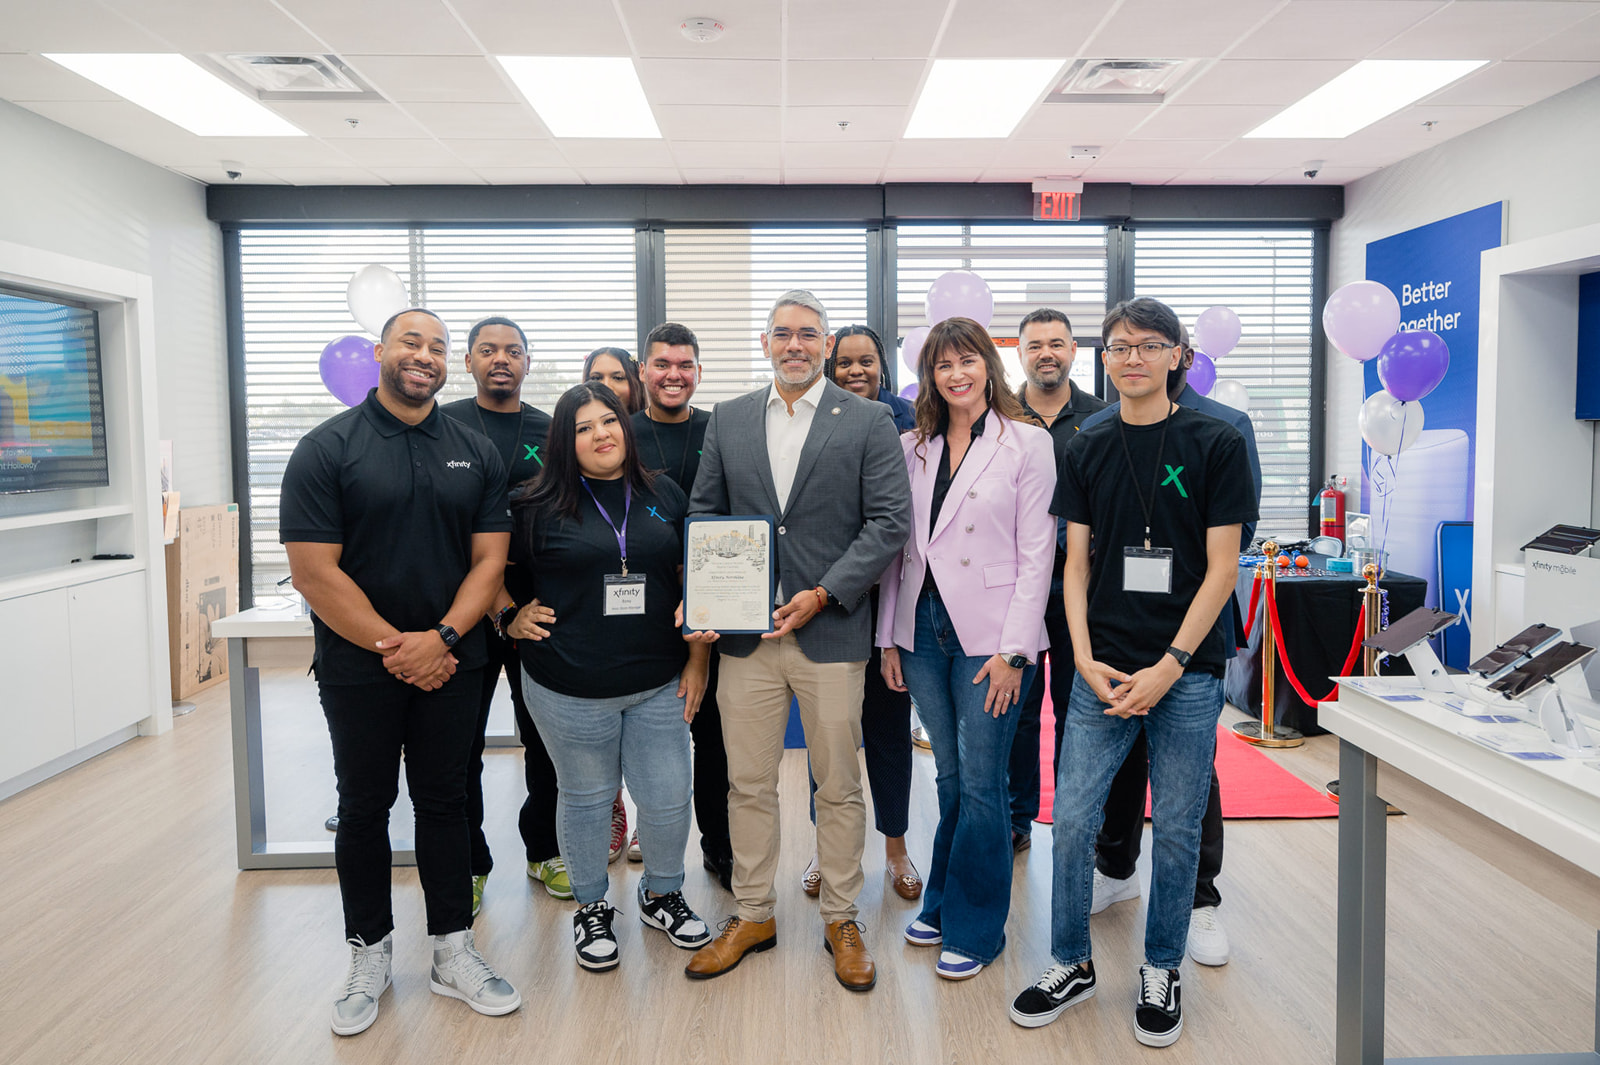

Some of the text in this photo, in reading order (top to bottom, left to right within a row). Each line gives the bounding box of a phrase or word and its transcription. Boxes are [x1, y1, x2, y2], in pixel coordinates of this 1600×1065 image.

[1041, 192, 1076, 220] EXIT
[1402, 280, 1452, 307] Better
[1398, 308, 1461, 333] oether
[613, 587, 640, 598] xfinity
